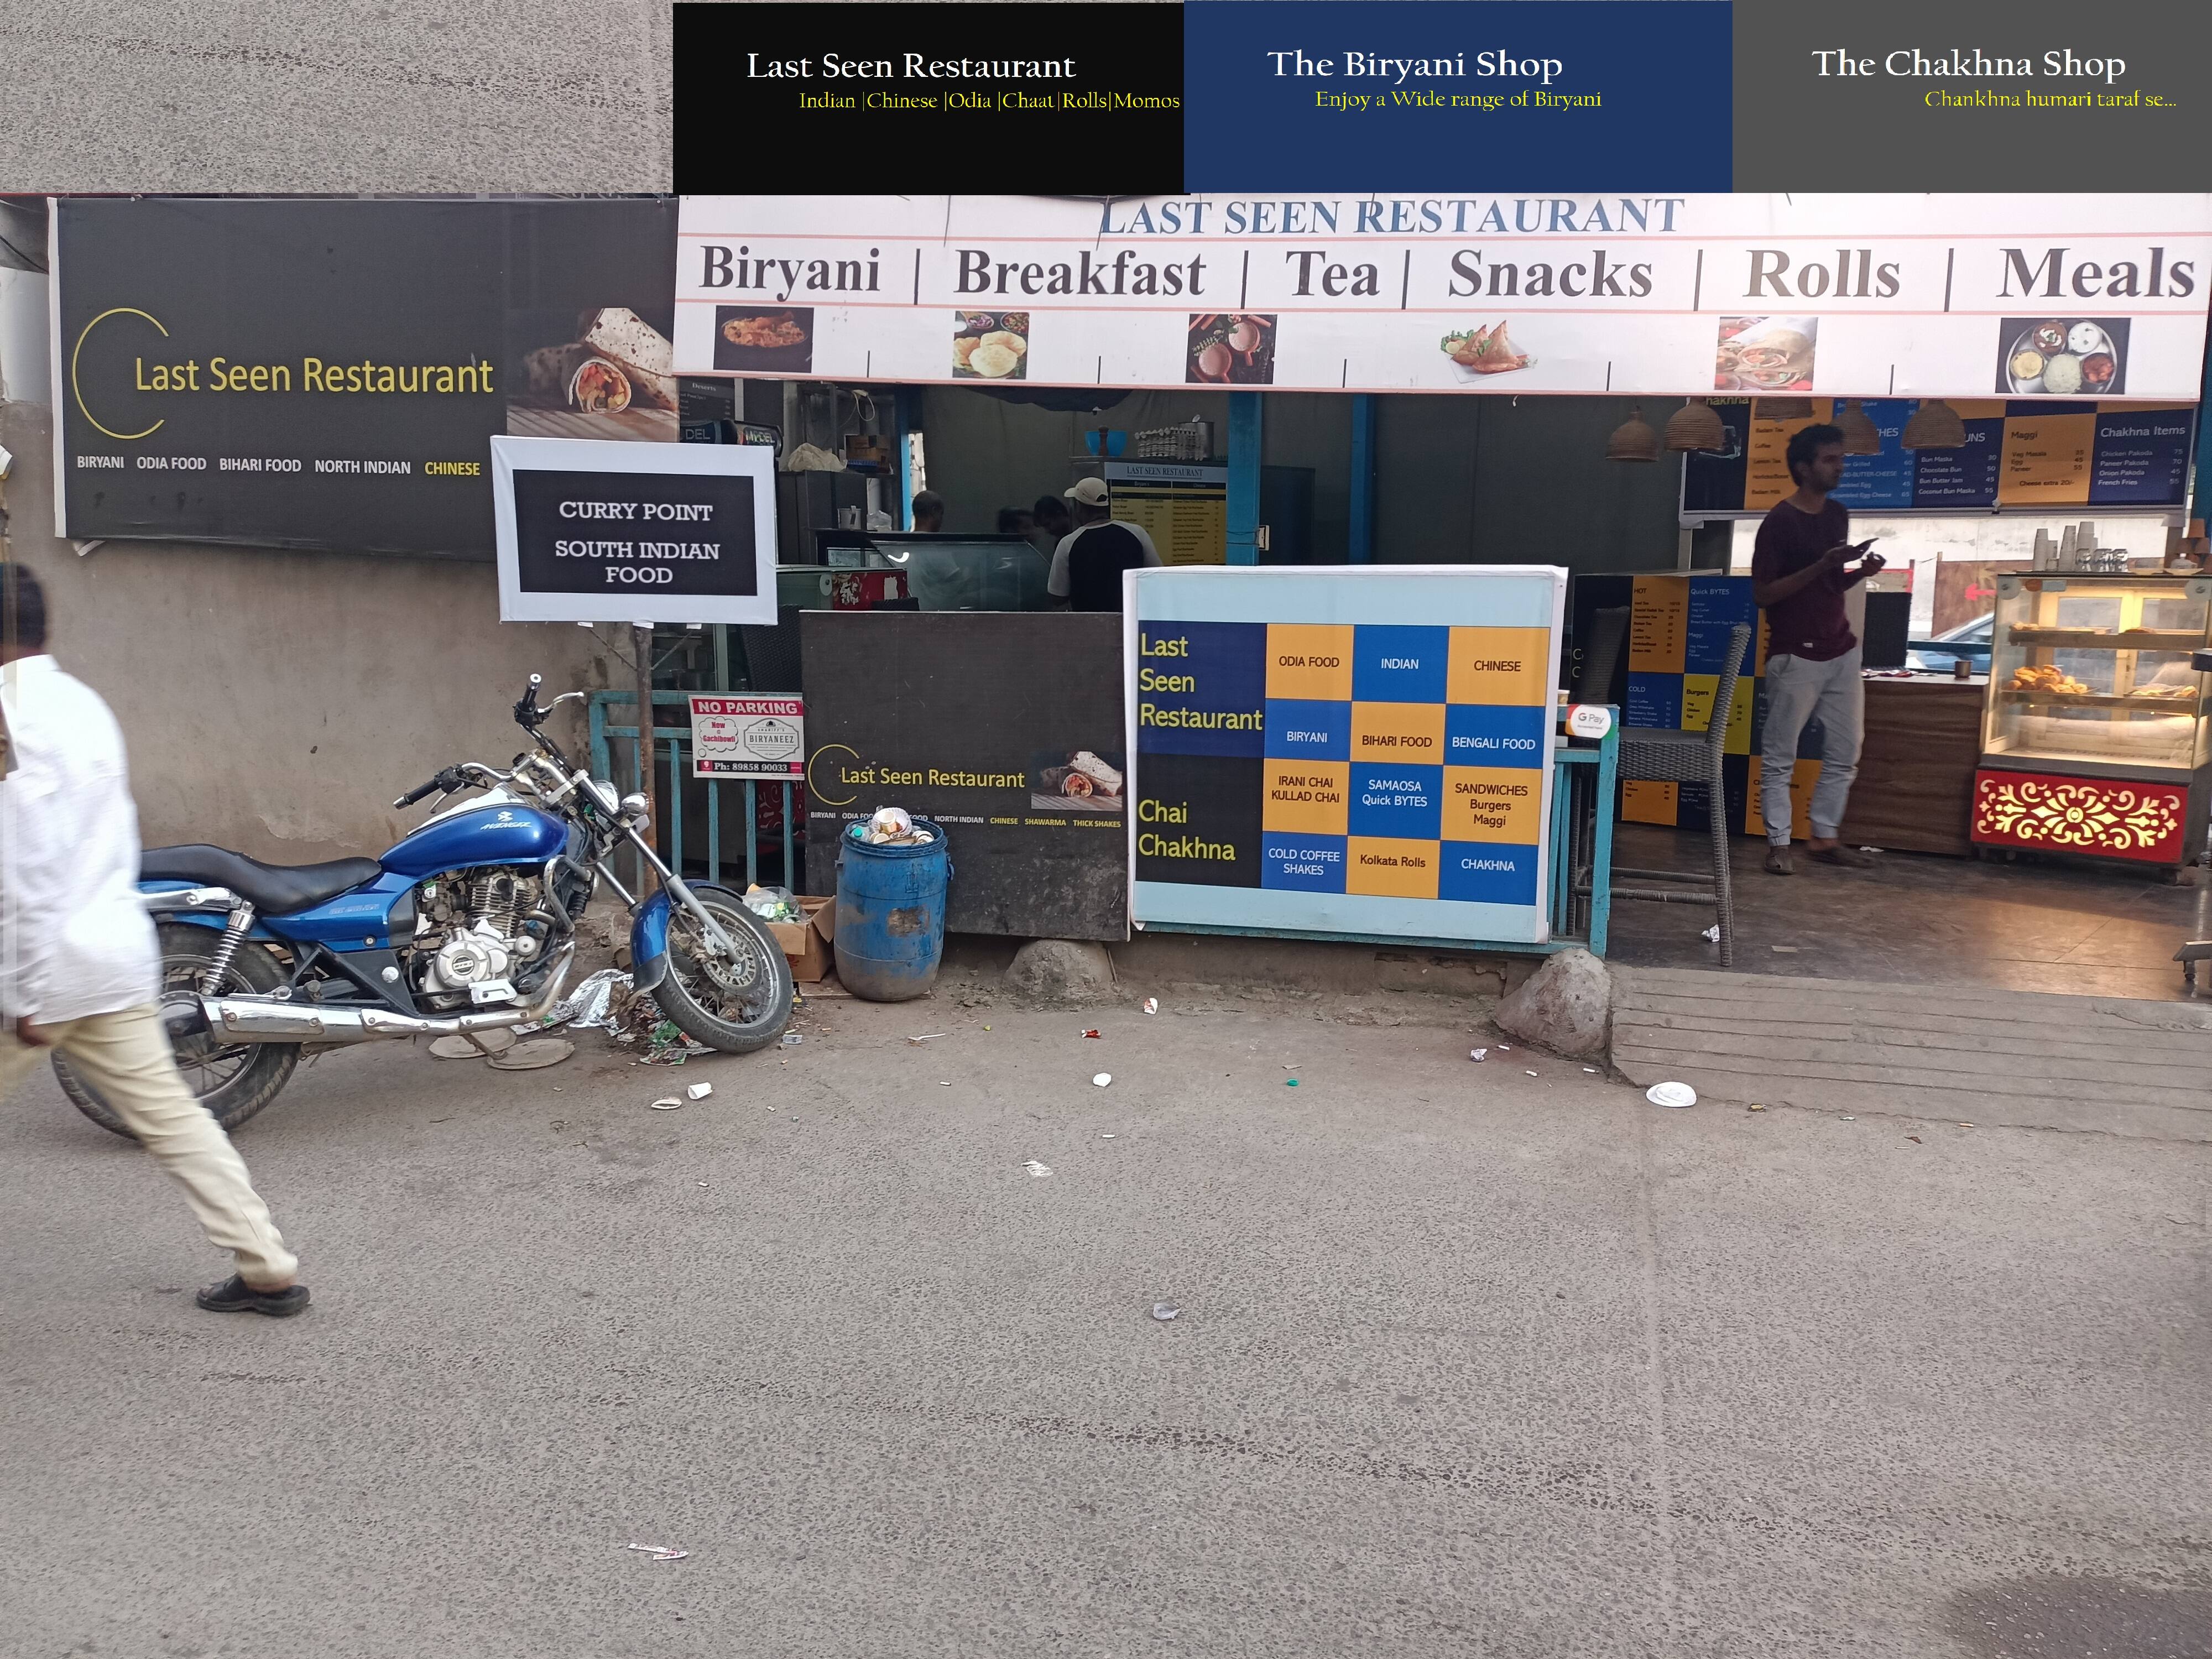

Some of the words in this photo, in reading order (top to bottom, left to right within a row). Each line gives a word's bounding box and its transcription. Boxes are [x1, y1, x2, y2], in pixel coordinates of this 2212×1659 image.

[1101, 201, 1213, 234] LAST
[1225, 201, 1341, 234] SEEN
[1354, 199, 1685, 233] RESTAURANT
[699, 246, 880, 302] Biryani
[953, 249, 1207, 296] Breakfast
[1286, 251, 1379, 296] Tea
[1449, 249, 1652, 298] Snacks
[1743, 249, 1900, 298] Rolls
[1996, 247, 2195, 298] Meals
[136, 357, 199, 392] Last
[210, 357, 291, 392] Seen
[304, 357, 493, 393] Restaurant
[1964, 432, 1985, 442] UNS
[2011, 431, 2038, 440] Maggi
[2101, 427, 2150, 437] Chakhna
[2154, 426, 2185, 435] Items
[77, 456, 124, 469] BIRYANI
[137, 457, 169, 470] ODIA
[171, 457, 207, 470] FOOD
[220, 458, 262, 472] BIHARI
[265, 458, 301, 472] FOOD
[315, 460, 361, 474] NORTH
[364, 461, 411, 474] INDIAN
[425, 461, 480, 476] CHINESE
[1145, 467, 1161, 475] SEEN
[1163, 468, 1203, 477] RESTAURANT
[560, 502, 638, 520] CURRY
[644, 504, 713, 521] POINT
[556, 540, 633, 558] SOUTH
[639, 542, 720, 560] INDIAN
[606, 567, 673, 583] FOOD
[1140, 633, 1188, 658] Last
[1279, 656, 1306, 667] ODIA
[1308, 657, 1340, 667] FOOD
[1381, 658, 1419, 670] INDIAN
[1474, 660, 1521, 672] CHINESE
[1139, 668, 1195, 692] Seen
[698, 702, 721, 712] NO
[726, 702, 797, 714] PARKING
[1140, 703, 1263, 731] Restaurant
[1589, 714, 1604, 724] Pay
[749, 735, 794, 743] BIRYANEEZ
[1287, 731, 1328, 743] BIRYANI
[1362, 735, 1397, 747] BIHARI
[1400, 736, 1432, 748] FOOD
[1452, 737, 1499, 749] BENGALI
[1503, 739, 1536, 750] FOOD
[841, 767, 875, 784] Last
[880, 768, 922, 785] Seen
[928, 769, 1025, 788] Restaurant
[1279, 776, 1306, 787] IRANI
[1308, 777, 1333, 789] CHAI
[1368, 780, 1422, 792] SAMAOSA
[1454, 783, 1528, 796] SANDWICHES
[1271, 790, 1312, 801] KULLAD
[1314, 792, 1340, 804] CHAI
[1362, 794, 1391, 806] Quick
[1394, 795, 1428, 807] BYTES
[1139, 800, 1188, 824] Chai
[1470, 799, 1511, 813] Burgers
[1473, 813, 1506, 827] Maggi
[1139, 834, 1236, 861] Chakhna
[1268, 848, 1298, 860] COLD
[1300, 849, 1340, 863] COFFEE
[1360, 854, 1399, 867] Kolkata
[1401, 855, 1426, 868] Rolls
[1283, 863, 1324, 875] SHAKES
[1460, 858, 1515, 872] CHAKHNA
